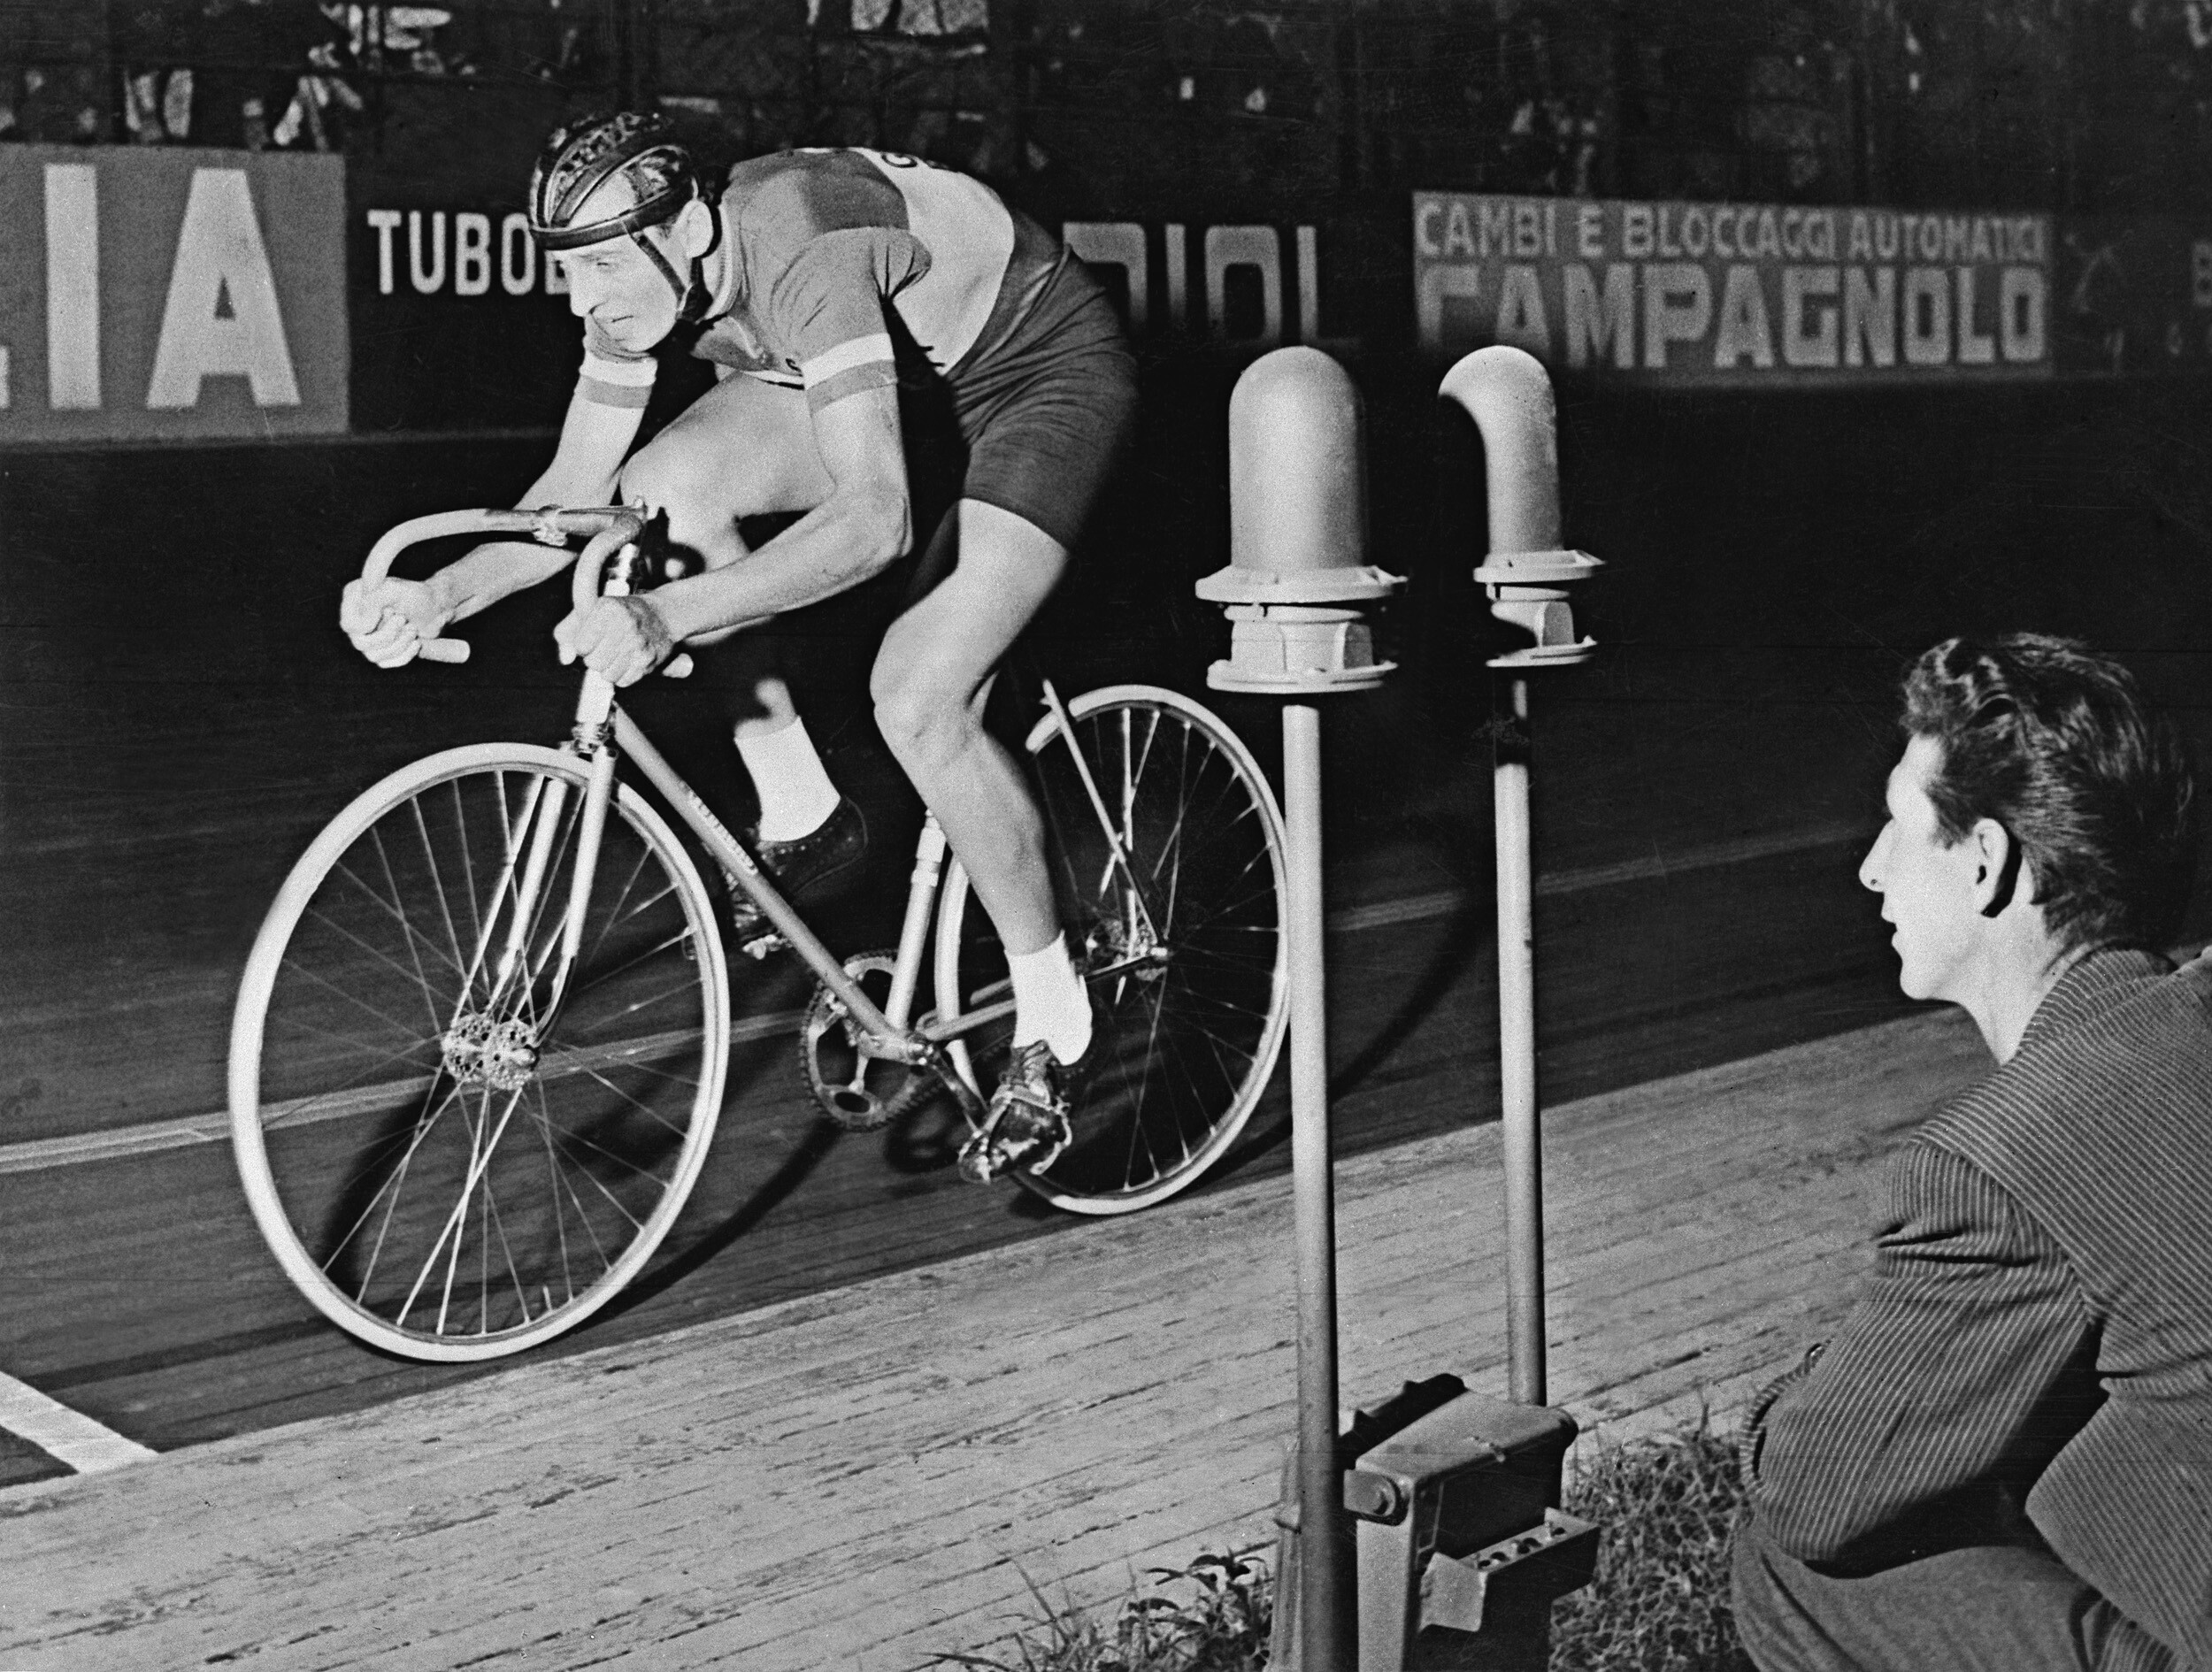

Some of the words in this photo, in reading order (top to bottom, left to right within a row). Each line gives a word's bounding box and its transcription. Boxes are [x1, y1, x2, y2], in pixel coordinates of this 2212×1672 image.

[0, 162, 302, 410] IA
[1417, 202, 1557, 257] CAMBI
[1578, 203, 1603, 257] E
[1623, 205, 1835, 259] BLOCCAGGI
[1847, 211, 2045, 263] AUTOMATICI
